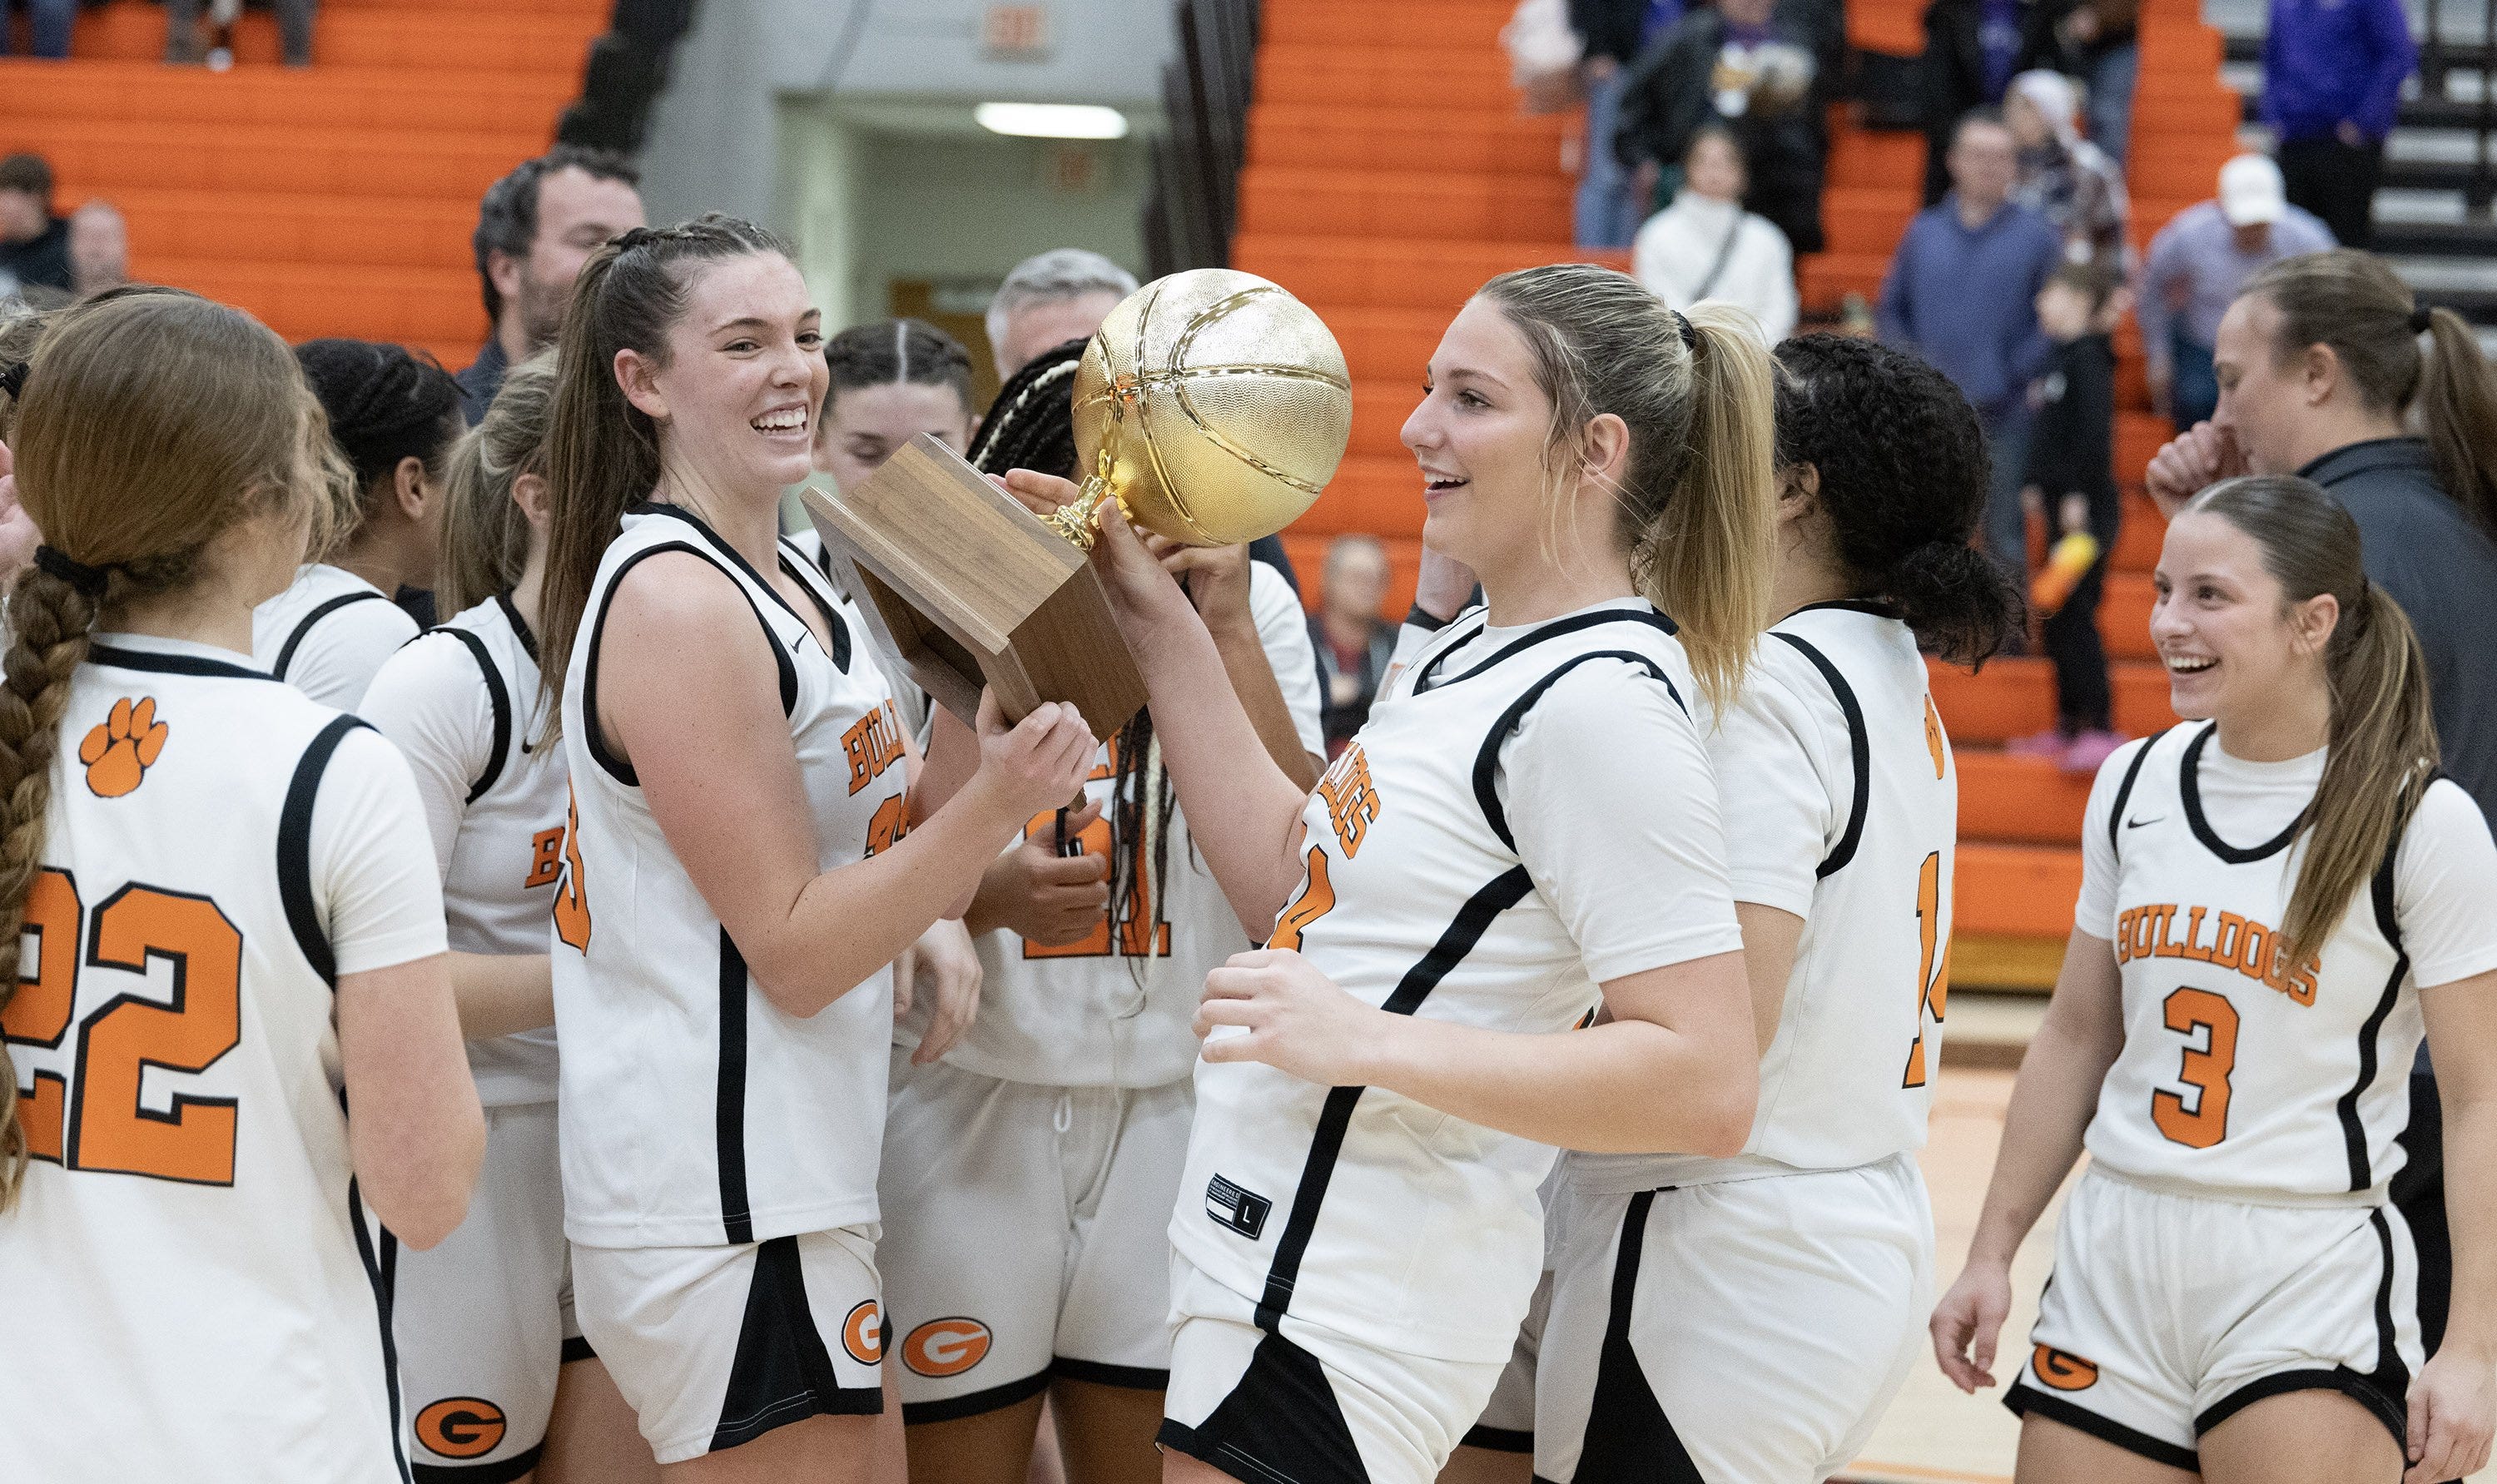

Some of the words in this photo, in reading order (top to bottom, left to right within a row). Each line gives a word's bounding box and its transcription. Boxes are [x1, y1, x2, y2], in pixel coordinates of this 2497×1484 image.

[2117, 902, 2322, 1009] BULLDOGS
[2150, 985, 2241, 1150] 3
[1243, 1205, 1250, 1223] L
[901, 1316, 993, 1378] G
[415, 1396, 507, 1461] G
